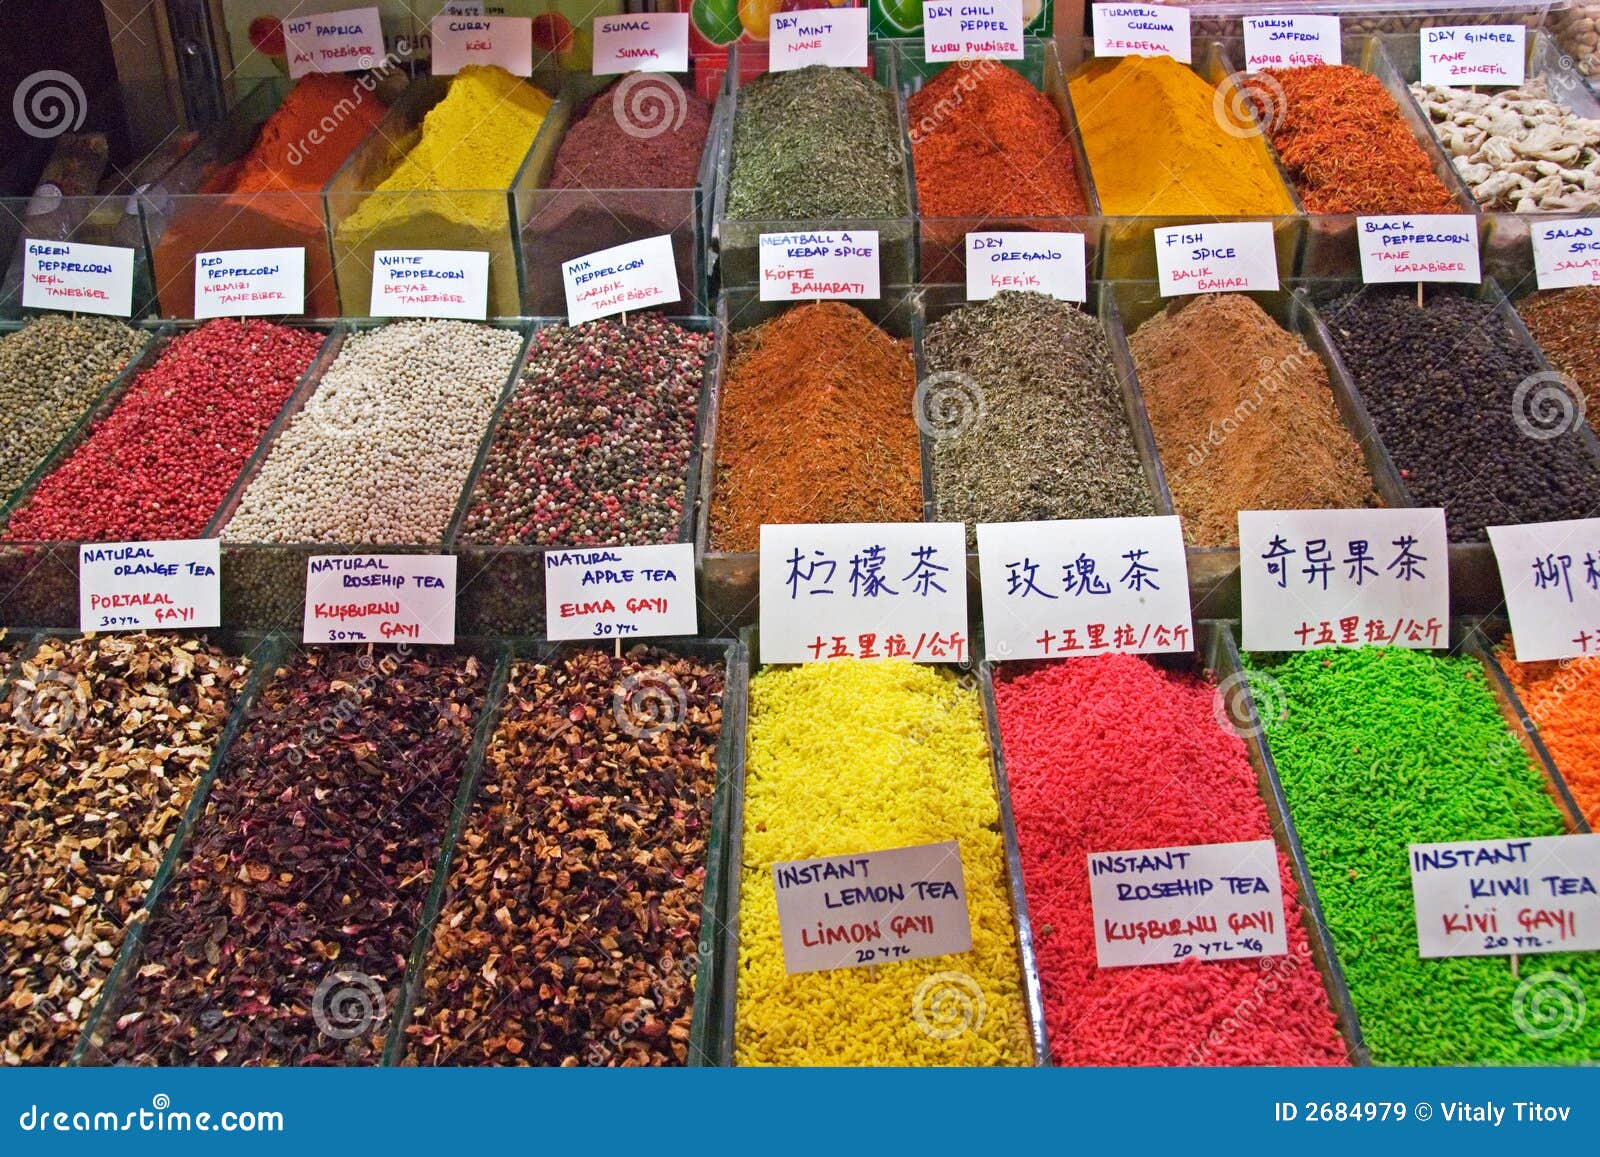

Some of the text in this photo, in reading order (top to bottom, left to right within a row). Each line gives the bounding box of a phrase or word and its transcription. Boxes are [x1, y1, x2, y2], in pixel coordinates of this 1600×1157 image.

[929, 6, 994, 18] DRY CHILI
[1100, 8, 1157, 16] TURMERIC
[289, 22, 363, 36] HOT PAPRICA
[450, 22, 490, 31] CURRY
[602, 21, 650, 33] SUMAC
[776, 17, 797, 29] DRY
[961, 20, 1008, 31] PEPPER
[1128, 22, 1174, 31] CURCUMA
[1249, 20, 1293, 28] TURKISH
[799, 25, 832, 36] MINT
[1269, 32, 1319, 40] SAFFRON
[1429, 31, 1515, 43] DRY GINGER
[788, 40, 822, 52] NANE
[1249, 55, 1282, 64] ASPUR
[1430, 52, 1466, 63] TANE
[1365, 221, 1414, 232] BLACK
[1166, 233, 1203, 246] FISH
[1544, 227, 1592, 240] SALAD
[761, 235, 834, 246] MEATBALL
[973, 238, 1003, 249] DRY
[1383, 234, 1469, 246] PEPPERCORN
[29, 245, 69, 256] GREEN
[788, 247, 872, 258] KEBAP SPICE
[991, 250, 1061, 262] OREGANO
[1192, 248, 1236, 260] SPICE
[1371, 251, 1410, 261] TANE
[201, 258, 222, 267] RED
[379, 256, 422, 265] WHITE
[38, 260, 112, 274] PEPPERCORN
[209, 266, 278, 278] PEPPERCORN
[569, 261, 590, 275] MIX
[390, 269, 464, 279] PEPPERCORN
[1172, 267, 1212, 281] BALIK
[791, 283, 864, 294] BAHARATI
[84, 547, 154, 563] NATURAL
[547, 552, 621, 568] NATURAL
[114, 562, 215, 576] ORANGE TEA
[311, 558, 389, 573] NATURAL
[582, 570, 676, 586] APPLE TEA
[1004, 549, 1160, 599] 玫瑰茶
[344, 574, 444, 589] ROSEHIP TEA
[560, 600, 615, 617] ELMA
[593, 623, 612, 635] 30
[1414, 842, 1531, 872] INSTANT
[1092, 851, 1190, 876] INSTANT
[778, 859, 869, 889] INSTANT
[1117, 876, 1269, 901] ROSEHIP TEA
[1470, 876, 1597, 898] KIWI TEA
[825, 882, 958, 909] LEMON TEA
[856, 949, 874, 963] 20
[1174, 943, 1192, 958] 20
